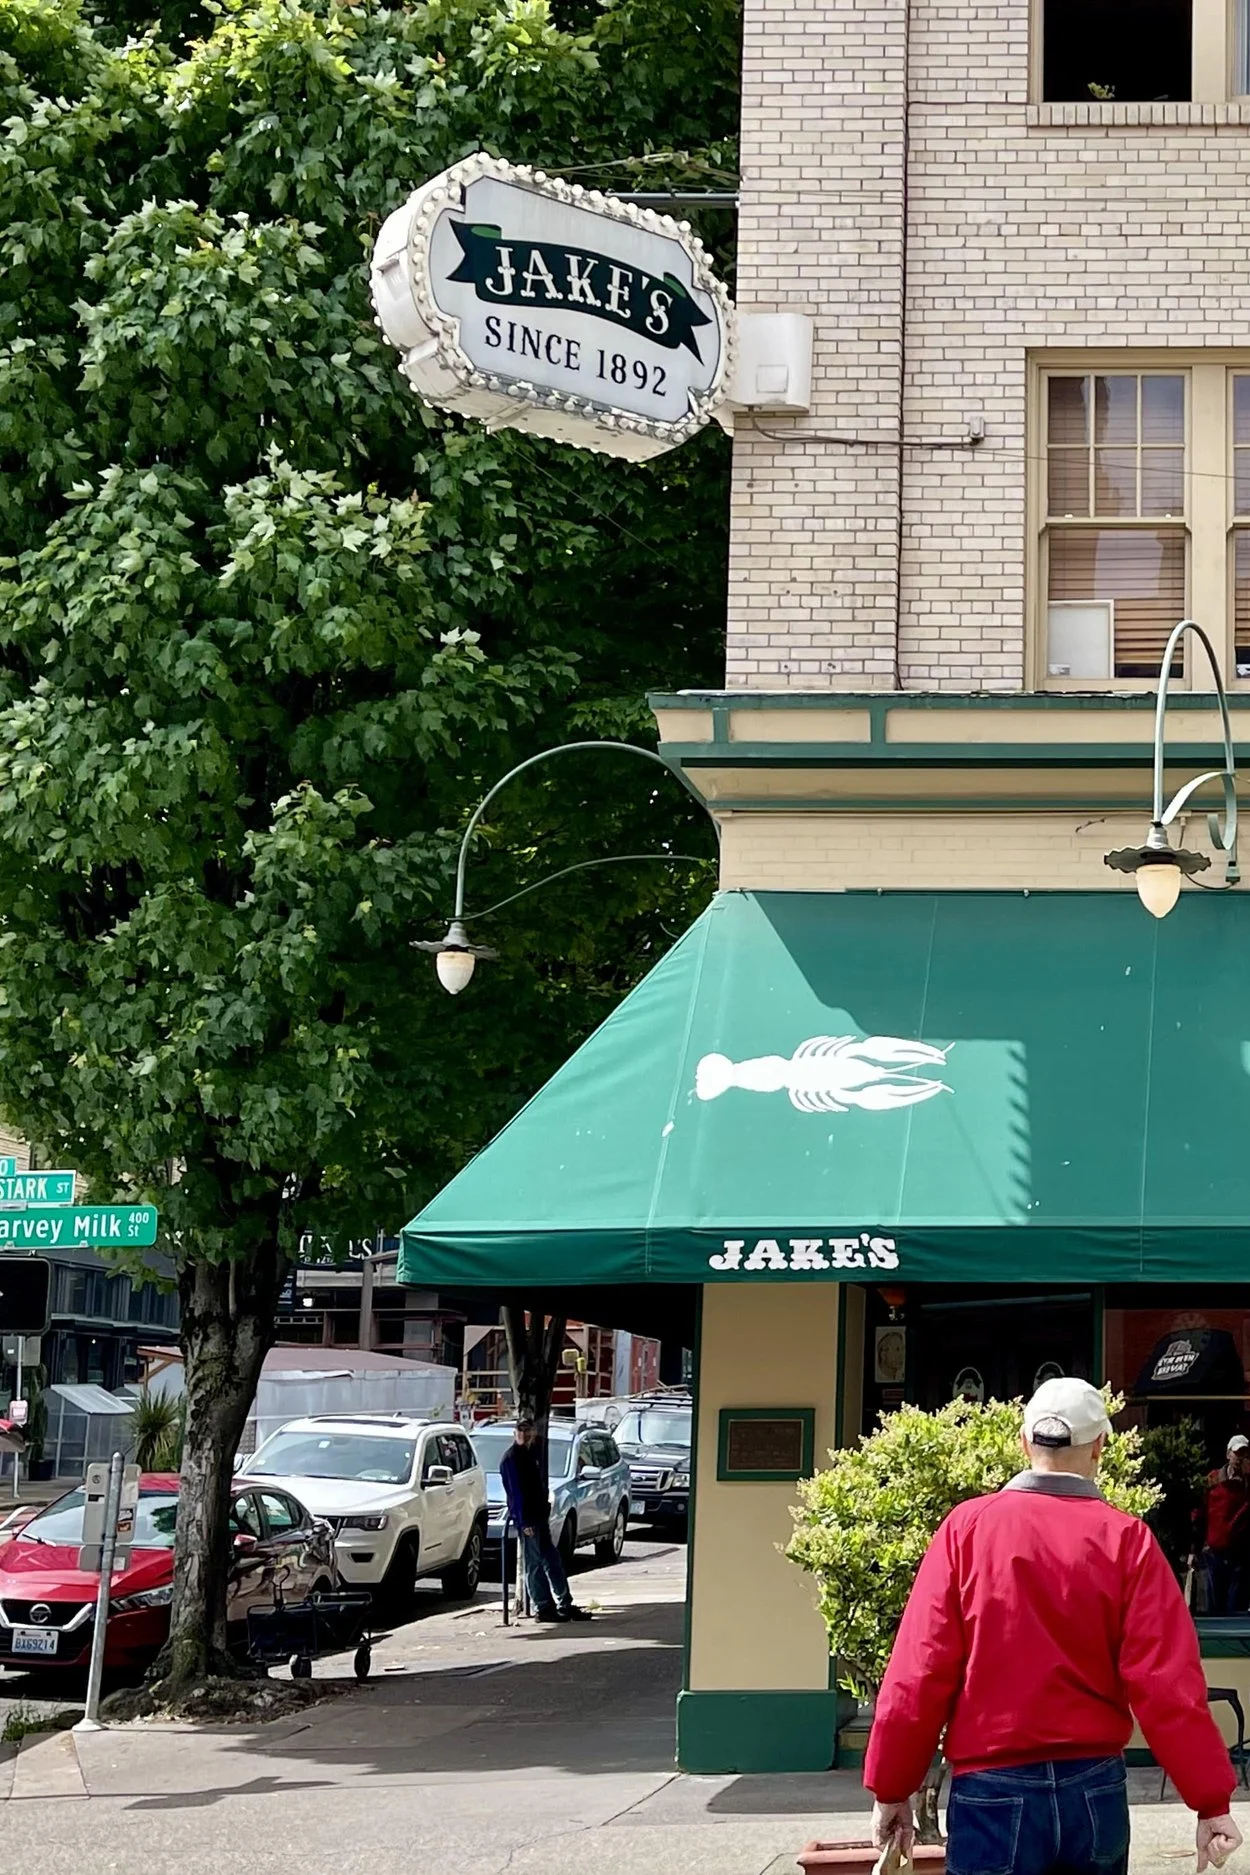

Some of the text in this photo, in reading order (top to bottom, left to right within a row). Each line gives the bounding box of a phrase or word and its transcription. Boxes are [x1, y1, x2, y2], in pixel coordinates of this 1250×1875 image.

[484, 246, 674, 335] JAKE'S
[484, 316, 668, 398] SINCE 1892
[56, 1182, 70, 1194] ST
[73, 1214, 122, 1238] Milk
[127, 1225, 140, 1237] St
[128, 1212, 150, 1224] 400
[708, 1233, 900, 1271] JAKE'S
